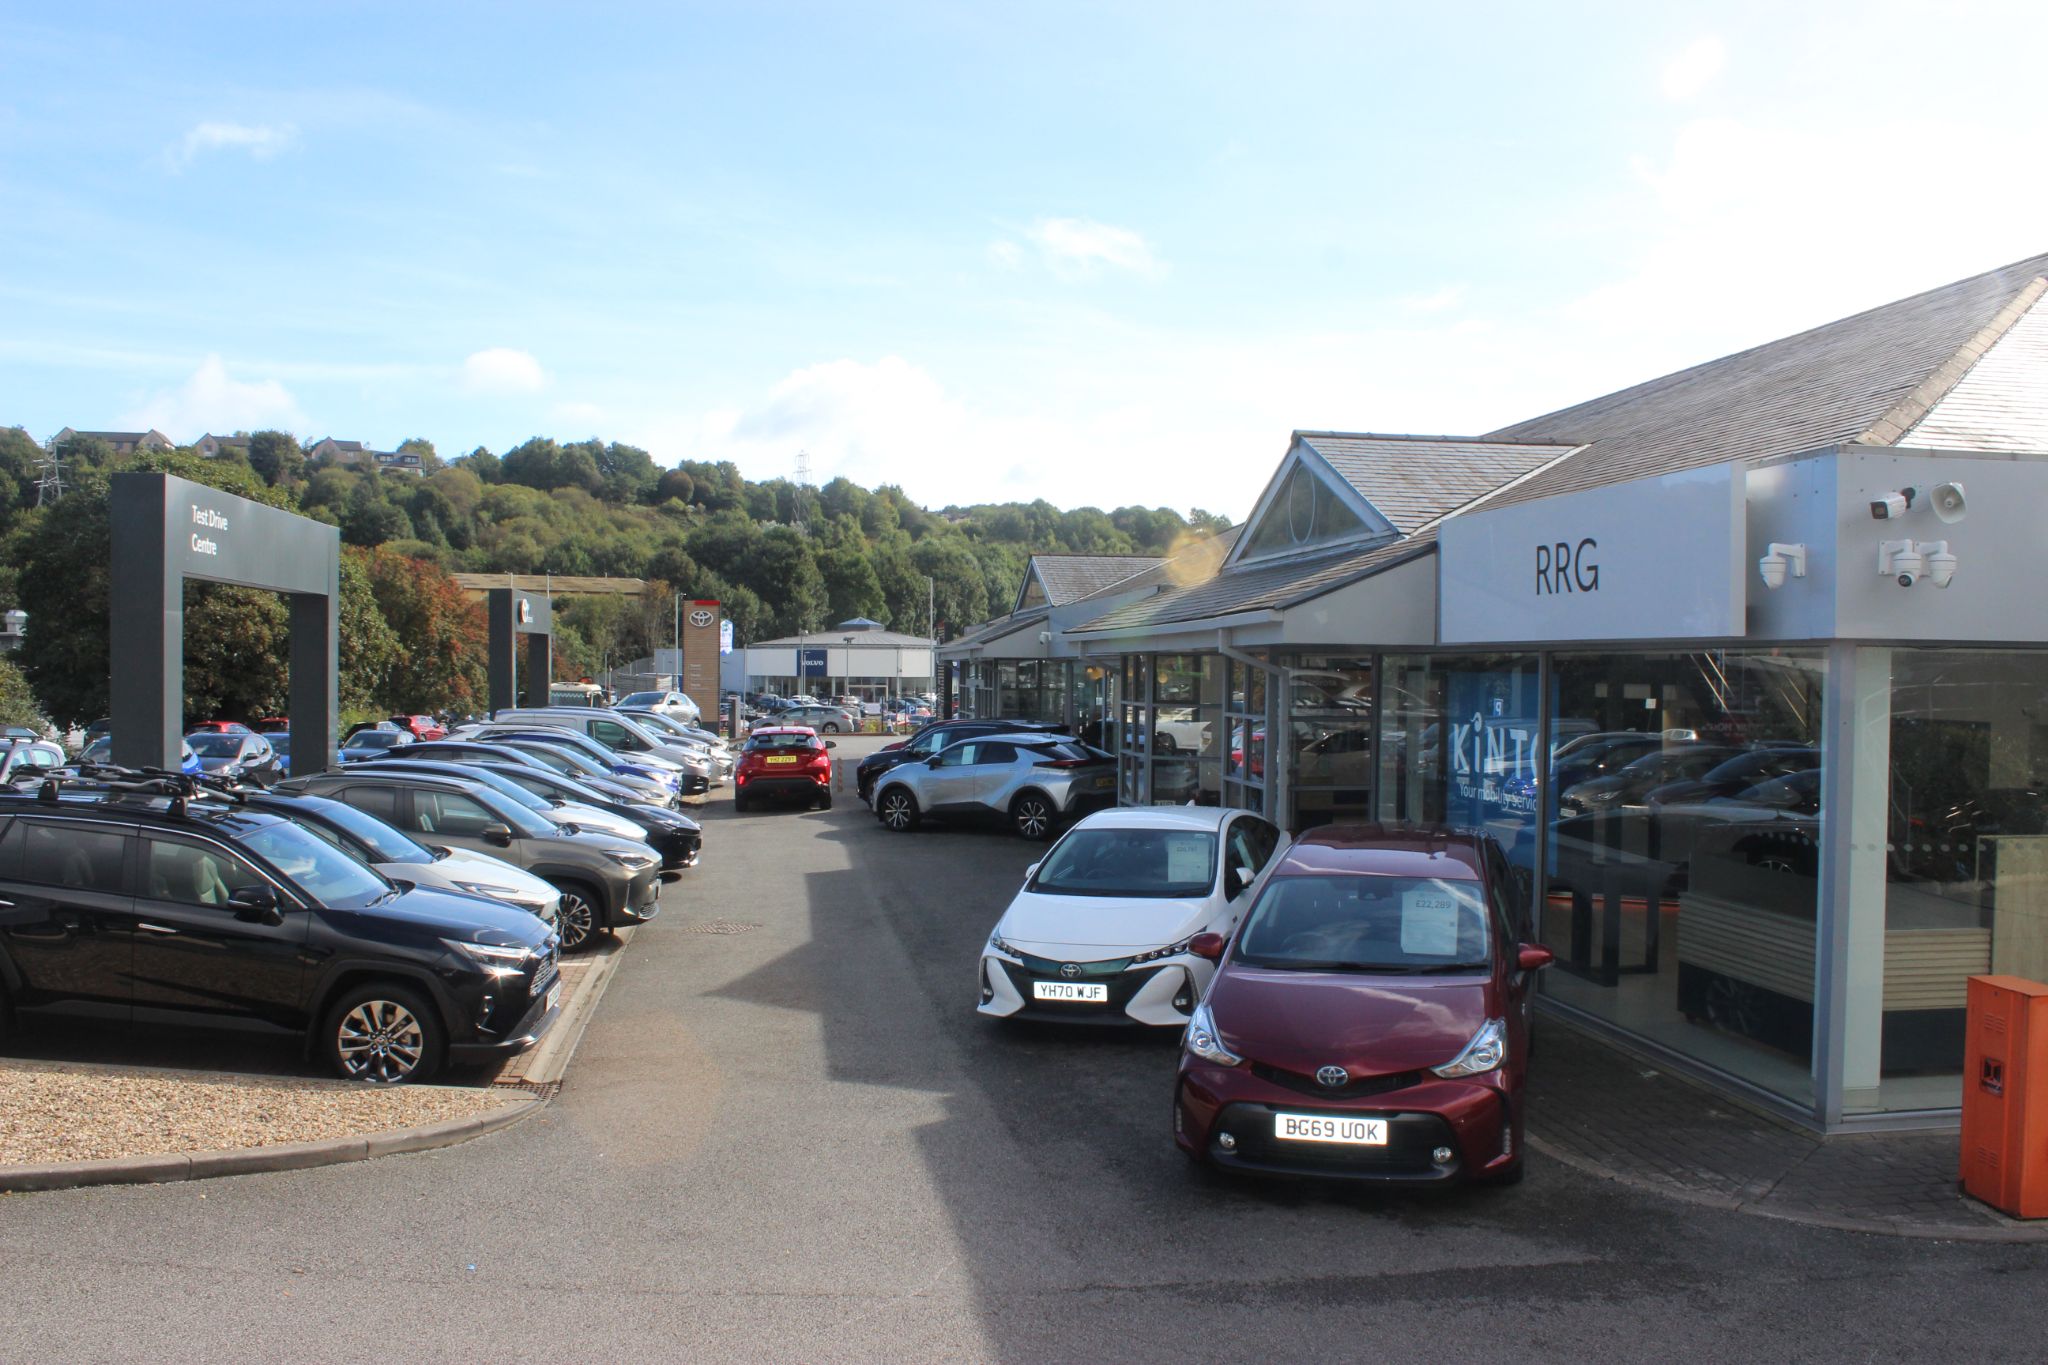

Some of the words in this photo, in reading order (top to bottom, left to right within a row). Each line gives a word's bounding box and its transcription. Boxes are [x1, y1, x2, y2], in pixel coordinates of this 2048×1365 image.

[191, 504, 208, 526] Test
[209, 509, 228, 531] Drive
[191, 533, 217, 555] Centre
[1536, 537, 1598, 595] RRG
[1460, 782, 1476, 799] Your
[1041, 984, 1073, 998] YH70
[1077, 986, 1101, 999] WJF
[1286, 1118, 1335, 1138] BG69
[1341, 1122, 1378, 1141] UOK
